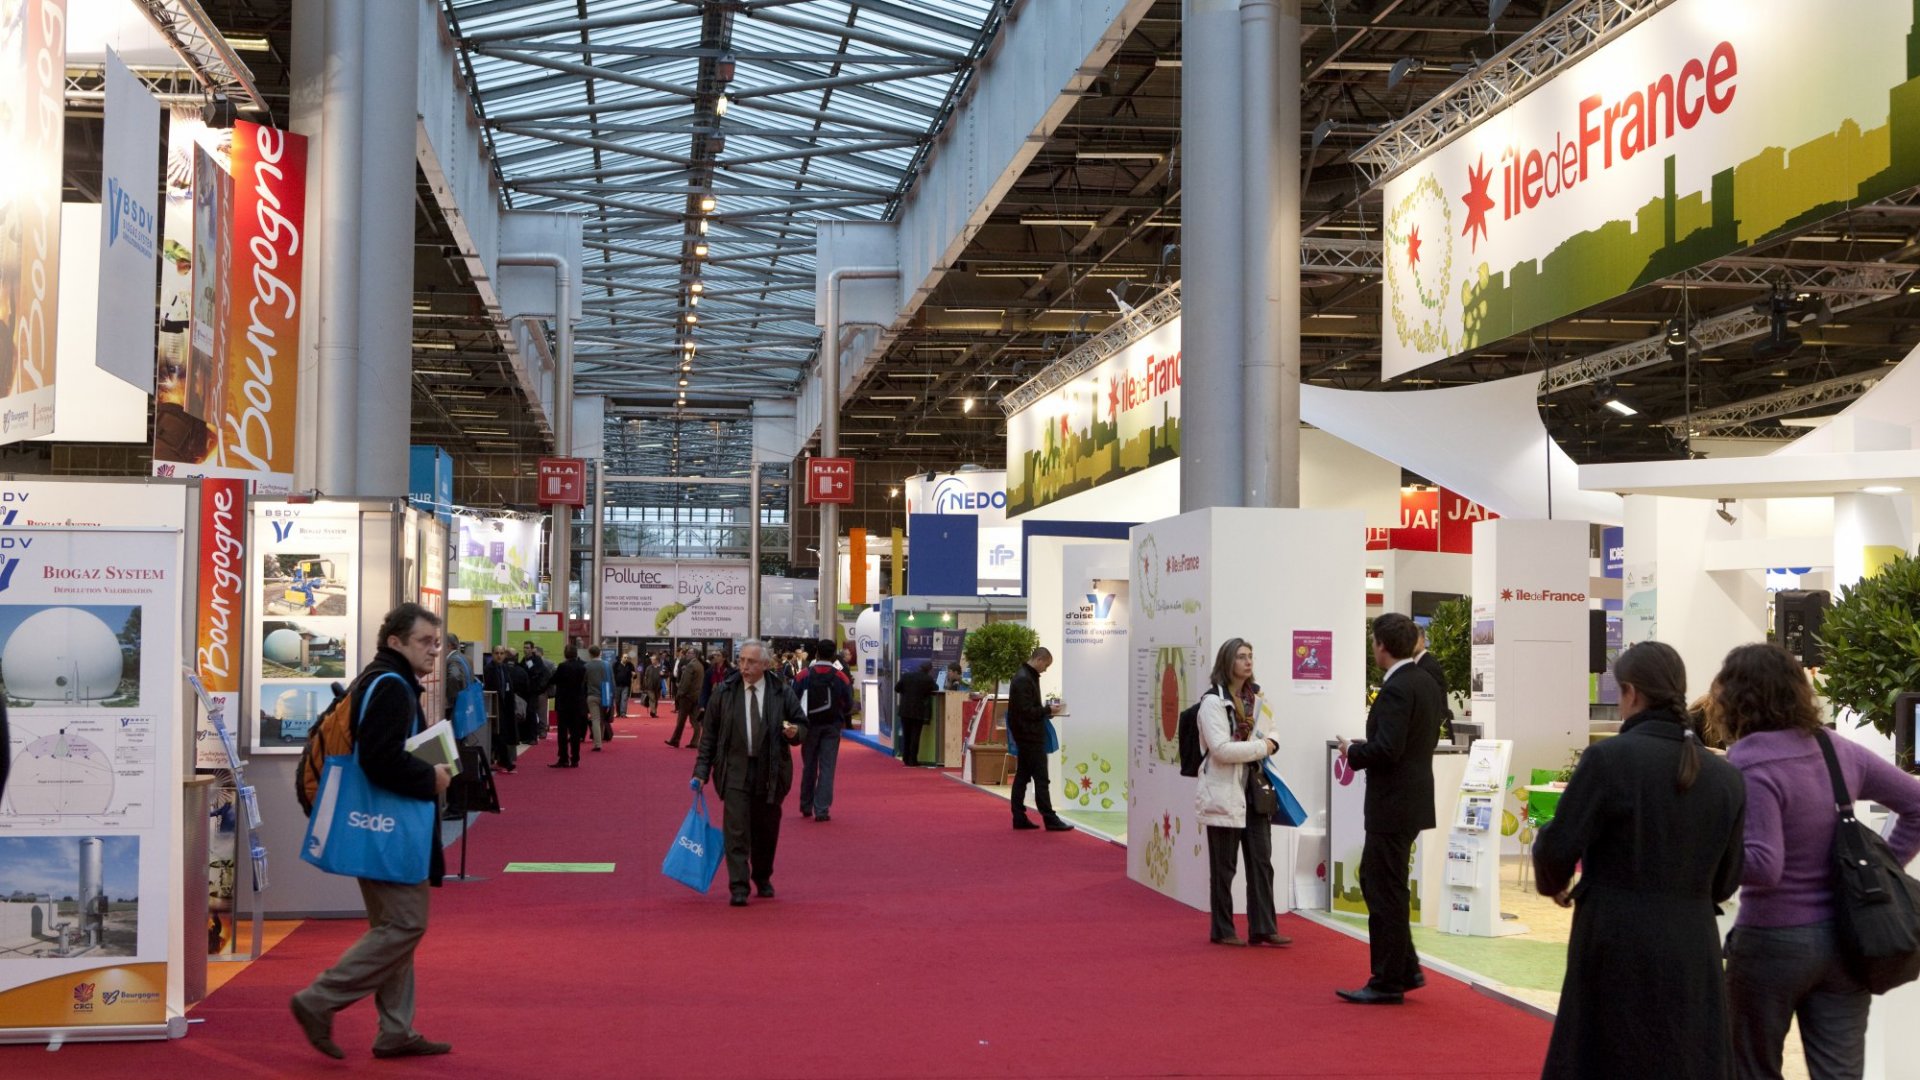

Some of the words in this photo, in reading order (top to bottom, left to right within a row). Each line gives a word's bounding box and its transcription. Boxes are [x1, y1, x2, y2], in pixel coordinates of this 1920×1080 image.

[123, 192, 154, 234] BSDV
[218, 125, 300, 473] Bourgogne
[542, 466, 578, 474] R.I.A.
[950, 491, 1006, 510] NEDO
[265, 509, 300, 517] BSDV
[989, 544, 1015, 566] ifp
[43, 566, 101, 580] BIOGAZ
[105, 566, 165, 580] SYSTEM
[198, 488, 242, 677] Bourgogne
[604, 567, 662, 584] Pollutec
[348, 811, 395, 833] sade
[121, 991, 160, 999] Bourgogne
